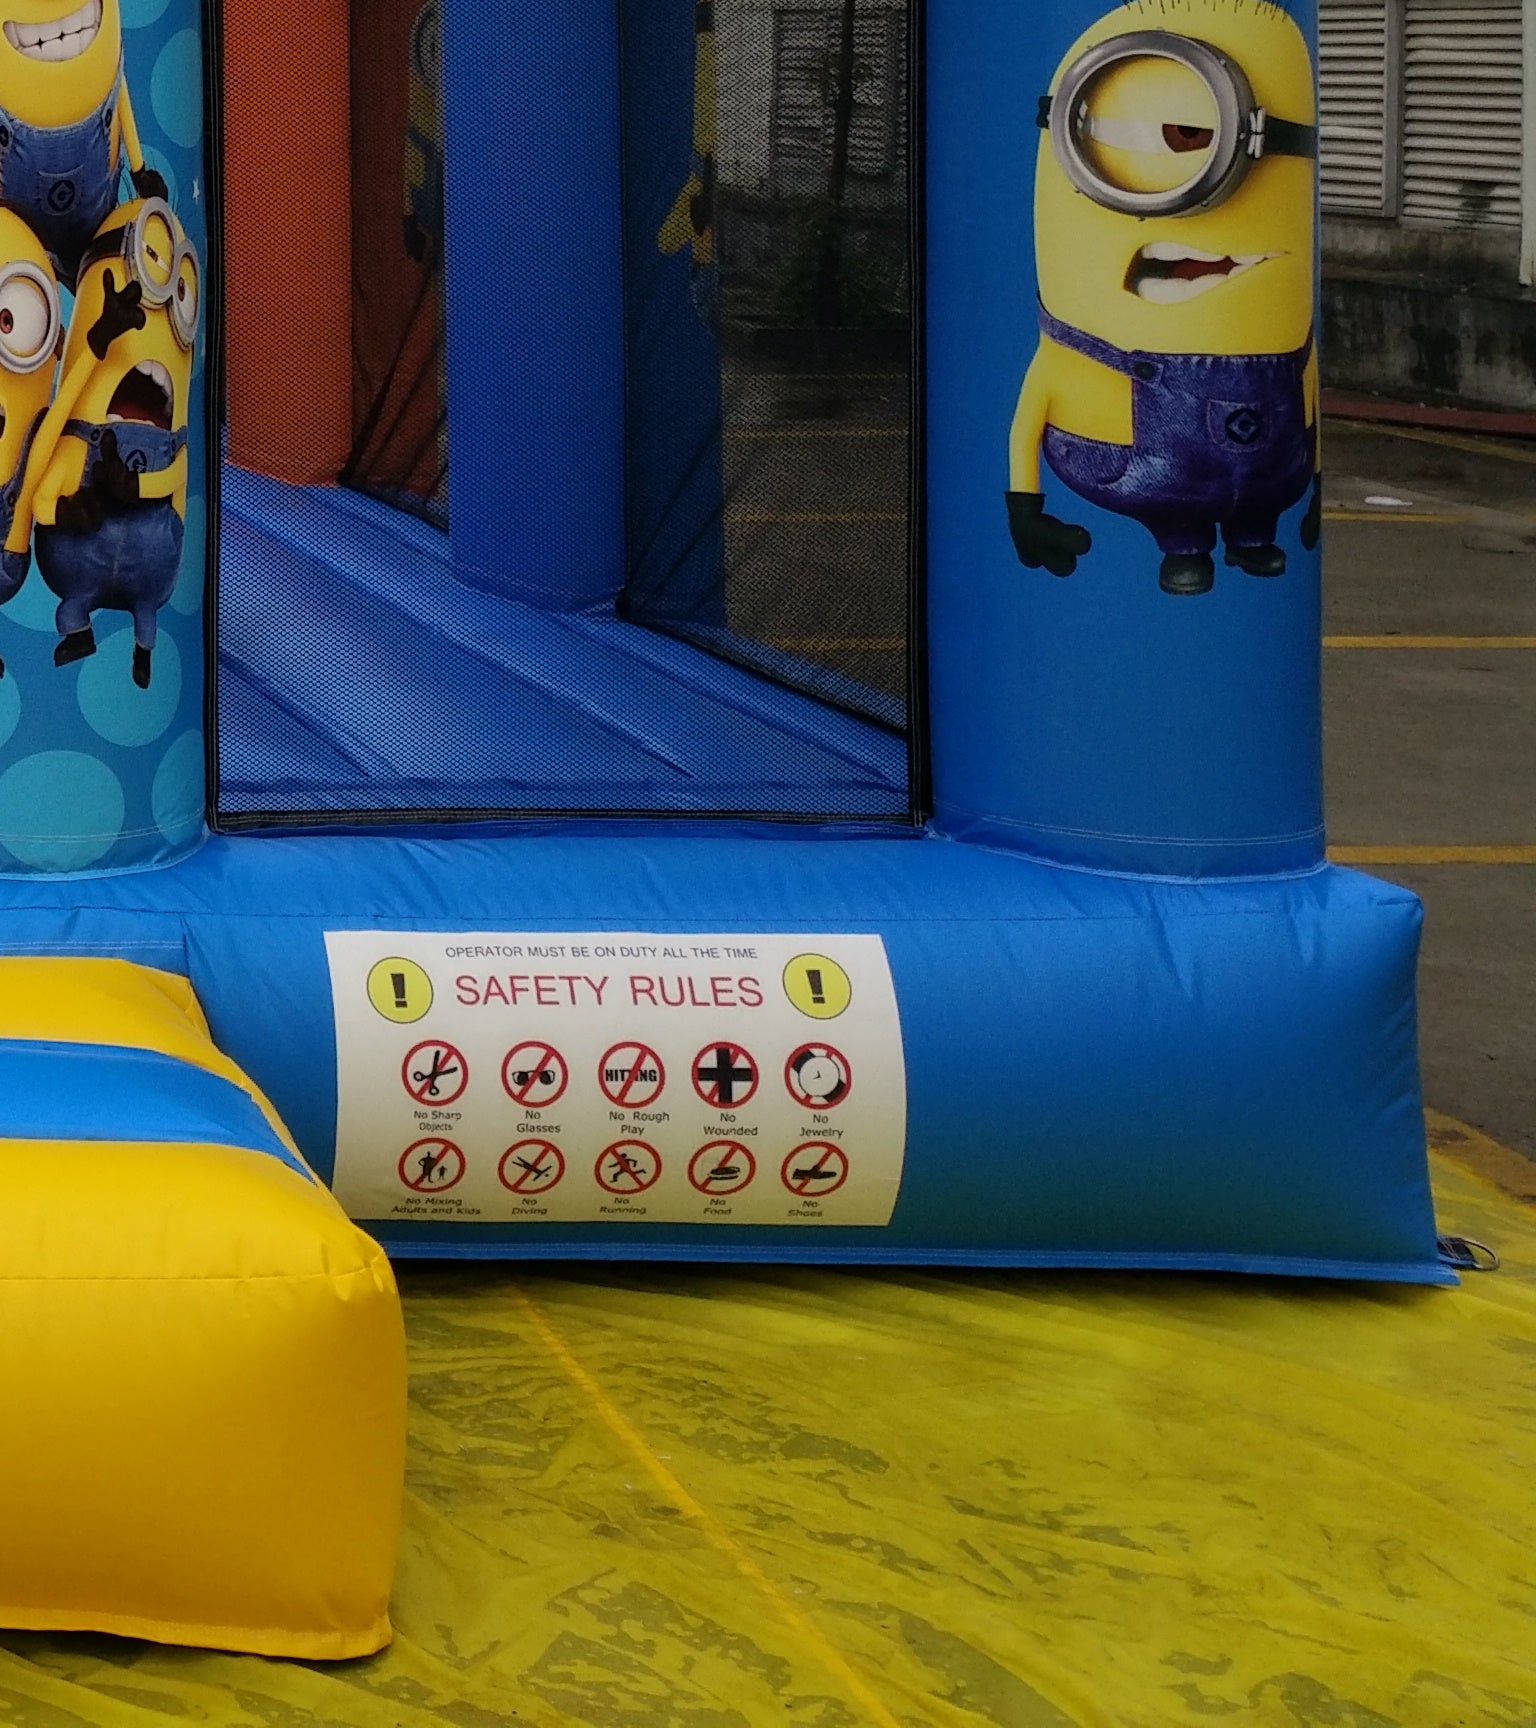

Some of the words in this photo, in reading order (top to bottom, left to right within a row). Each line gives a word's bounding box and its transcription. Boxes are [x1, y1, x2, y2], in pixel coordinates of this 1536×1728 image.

[445, 945, 524, 959] OPERATOR
[527, 946, 566, 958] MUST
[571, 946, 590, 958] BE
[594, 946, 616, 958] ON
[620, 946, 657, 958] DUTY
[663, 947, 687, 959] ALL
[690, 947, 720, 959] THE
[724, 947, 758, 959] TIME
[455, 975, 608, 1006] SAFETY
[629, 975, 764, 1007] RULES
[605, 1069, 658, 1082] HITNG
[413, 1110, 428, 1120] No
[431, 1110, 462, 1121] Sharp
[525, 1110, 541, 1120] No
[609, 1111, 625, 1121] No
[633, 1111, 670, 1122] Rough
[720, 1112, 736, 1123] No
[813, 1114, 829, 1124] No
[419, 1122, 453, 1132] Objects
[516, 1123, 561, 1134] Glasses
[620, 1124, 645, 1136] Play
[704, 1125, 758, 1136] Wounded
[800, 1127, 844, 1138] Jewelry
[406, 1197, 421, 1205] No
[424, 1197, 462, 1206] Mixing
[614, 1197, 630, 1205] No
[710, 1198, 726, 1206] No
[802, 1200, 818, 1208] No
[391, 1206, 428, 1214] Adults
[431, 1206, 453, 1215] and
[456, 1207, 481, 1215] Kids
[511, 1207, 548, 1216] Diving
[600, 1206, 647, 1215] Running
[703, 1208, 732, 1216] Food
